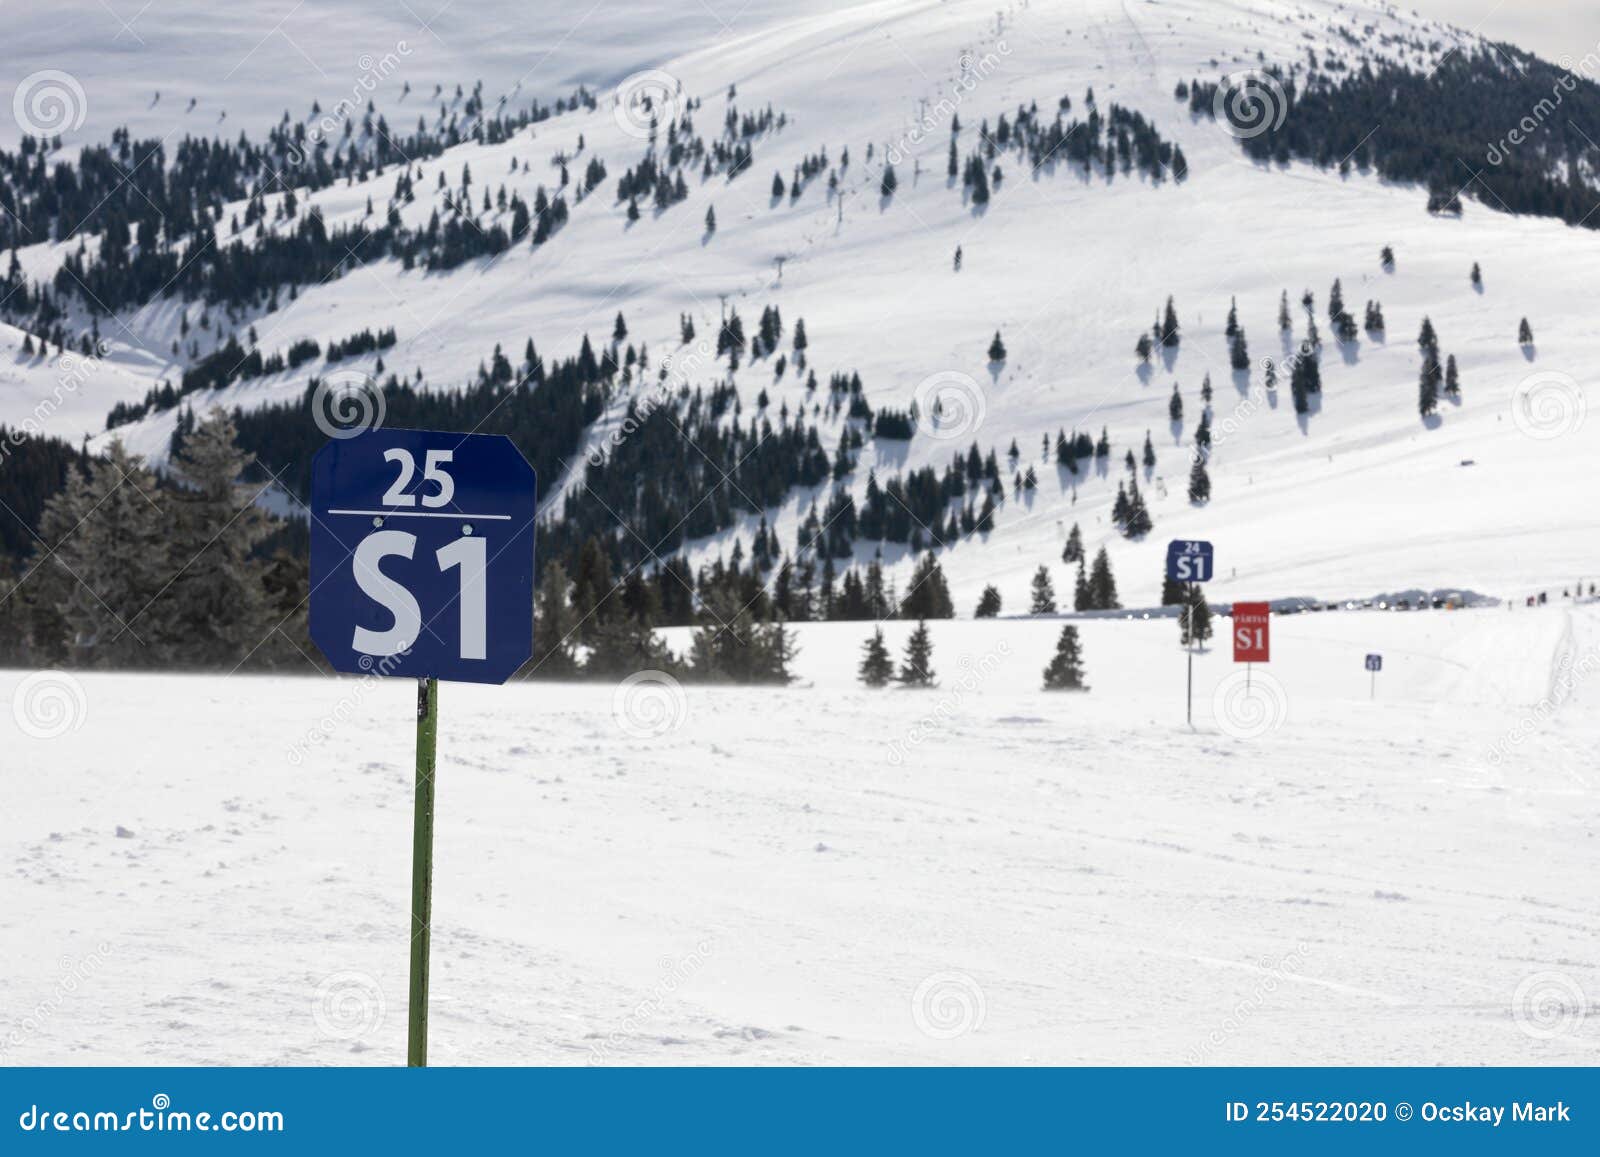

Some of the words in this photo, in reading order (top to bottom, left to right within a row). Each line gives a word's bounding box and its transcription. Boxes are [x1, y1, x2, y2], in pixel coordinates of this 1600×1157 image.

[382, 447, 455, 508] 25
[1184, 541, 1201, 555] 24
[1176, 556, 1205, 580] S1
[352, 529, 487, 661] S1
[1236, 627, 1265, 650] S1
